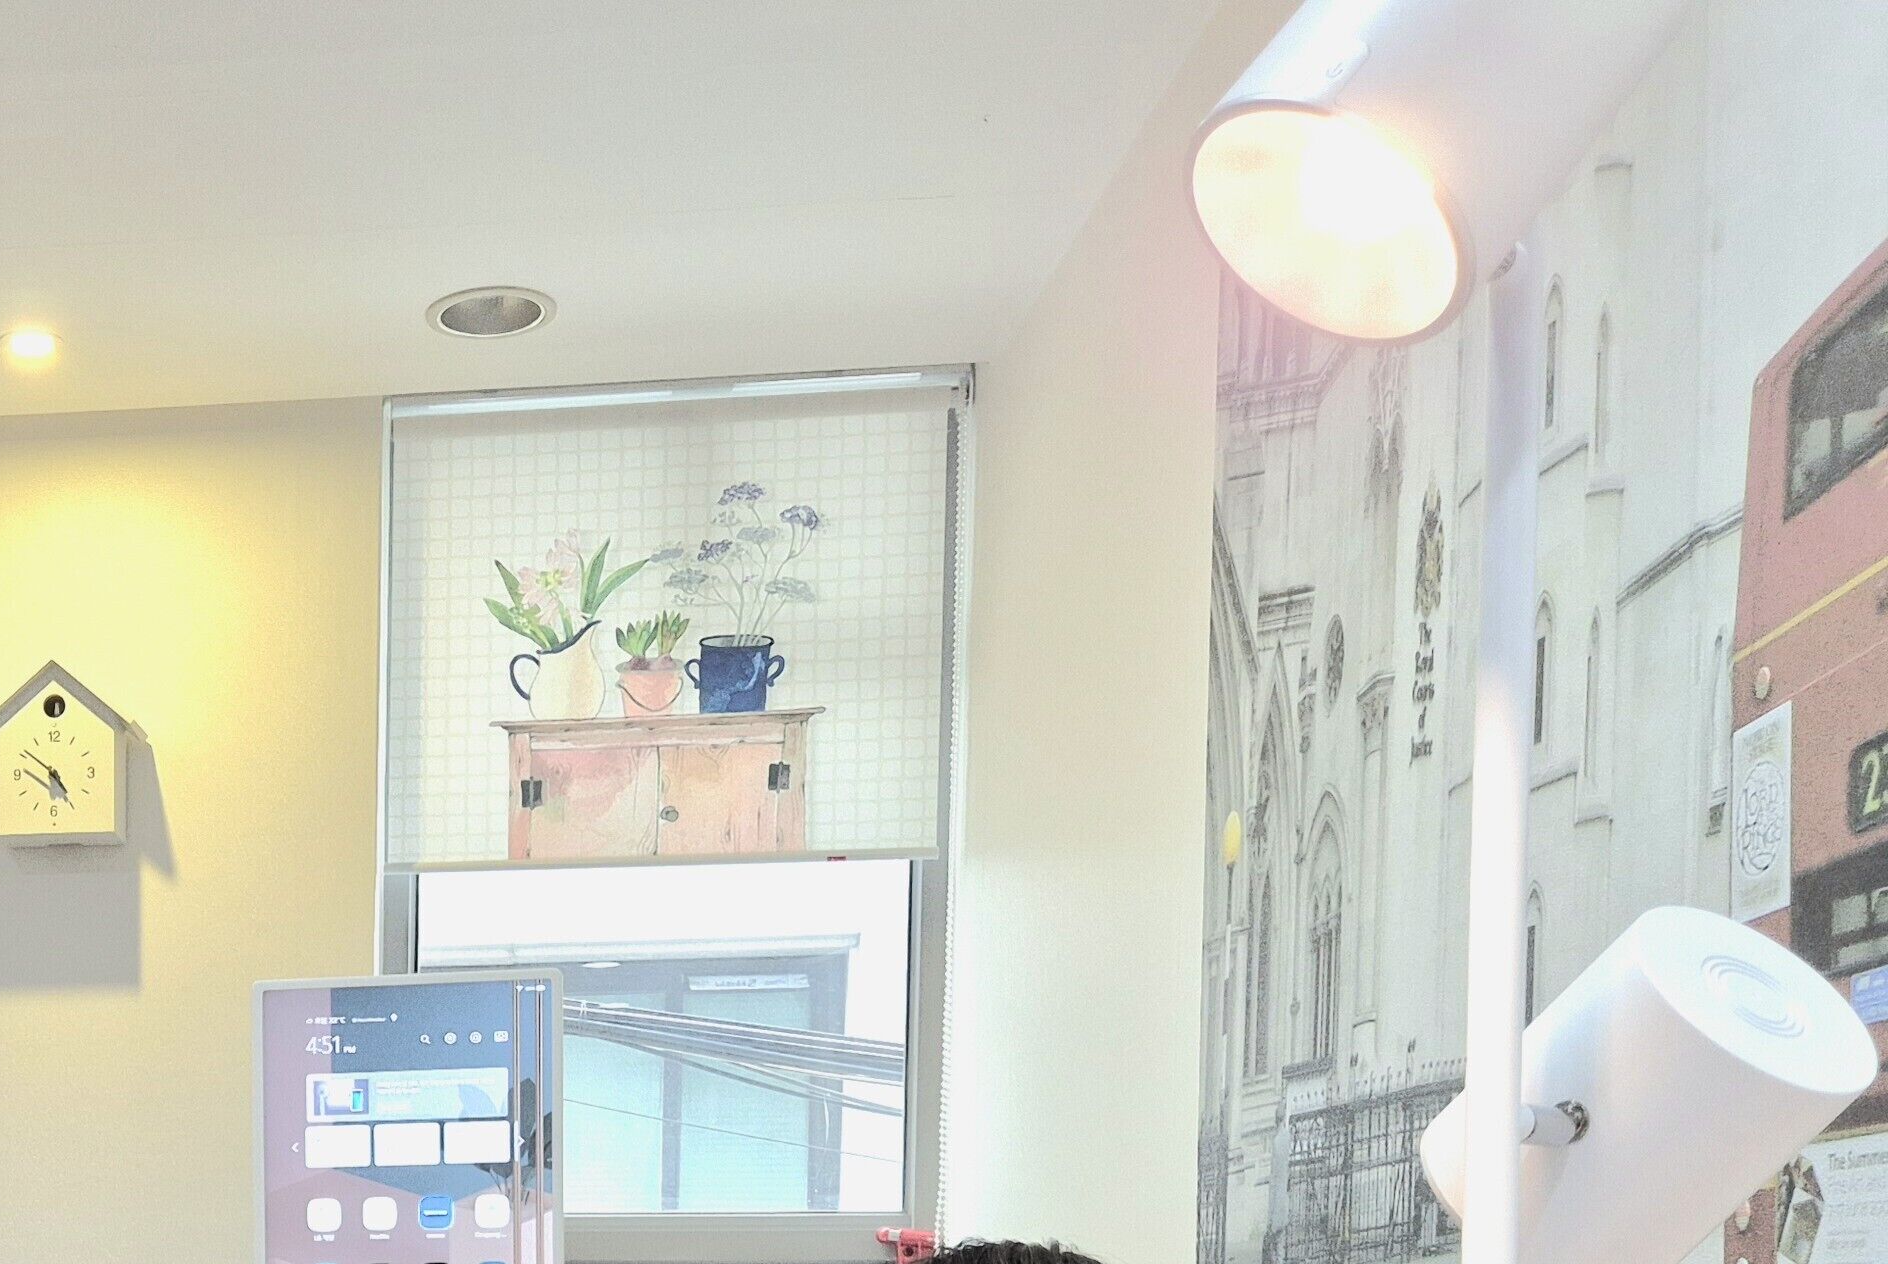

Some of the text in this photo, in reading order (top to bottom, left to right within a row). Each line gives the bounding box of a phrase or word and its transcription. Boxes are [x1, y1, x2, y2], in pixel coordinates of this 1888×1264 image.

[48, 730, 61, 742] 12
[13, 766, 95, 781] 9 3
[50, 805, 58, 817] 6
[306, 1035, 342, 1055] 4:51
